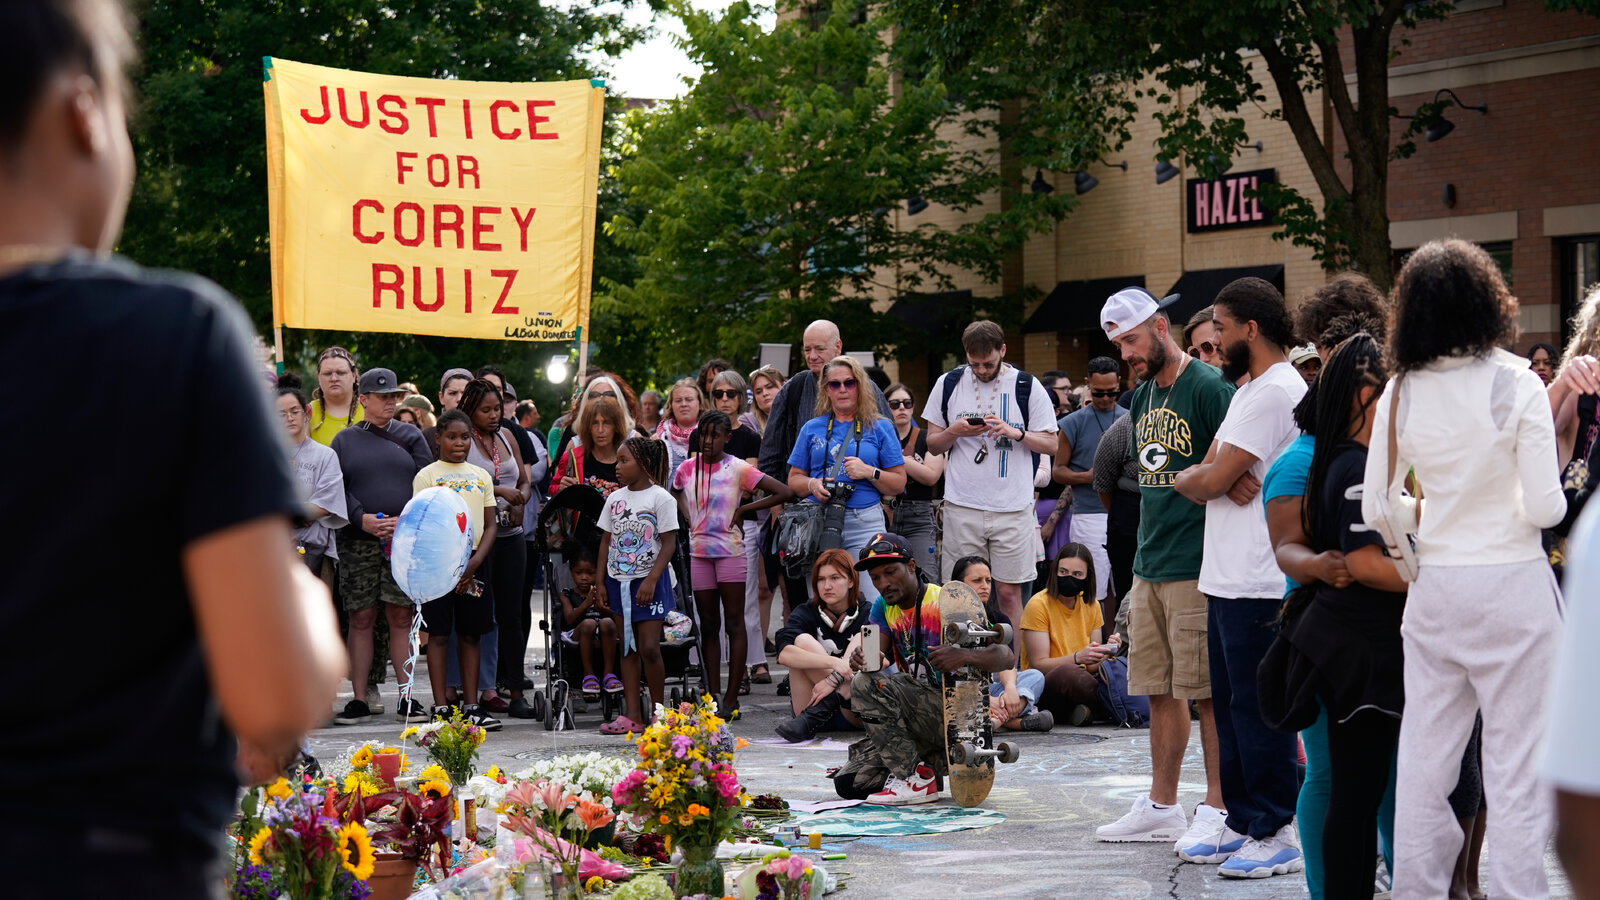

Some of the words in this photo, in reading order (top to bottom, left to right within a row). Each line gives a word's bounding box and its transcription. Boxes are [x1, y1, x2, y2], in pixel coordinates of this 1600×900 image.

[301, 86, 558, 139] JUSTICE
[397, 152, 480, 189] FOR
[1196, 176, 1263, 226] HAZEL
[353, 200, 535, 251] COREY
[372, 264, 519, 314] RUIZ
[504, 326, 540, 338] LABOR
[524, 317, 563, 328] UNION
[1139, 442, 1168, 472] G
[650, 604, 664, 616] 76
